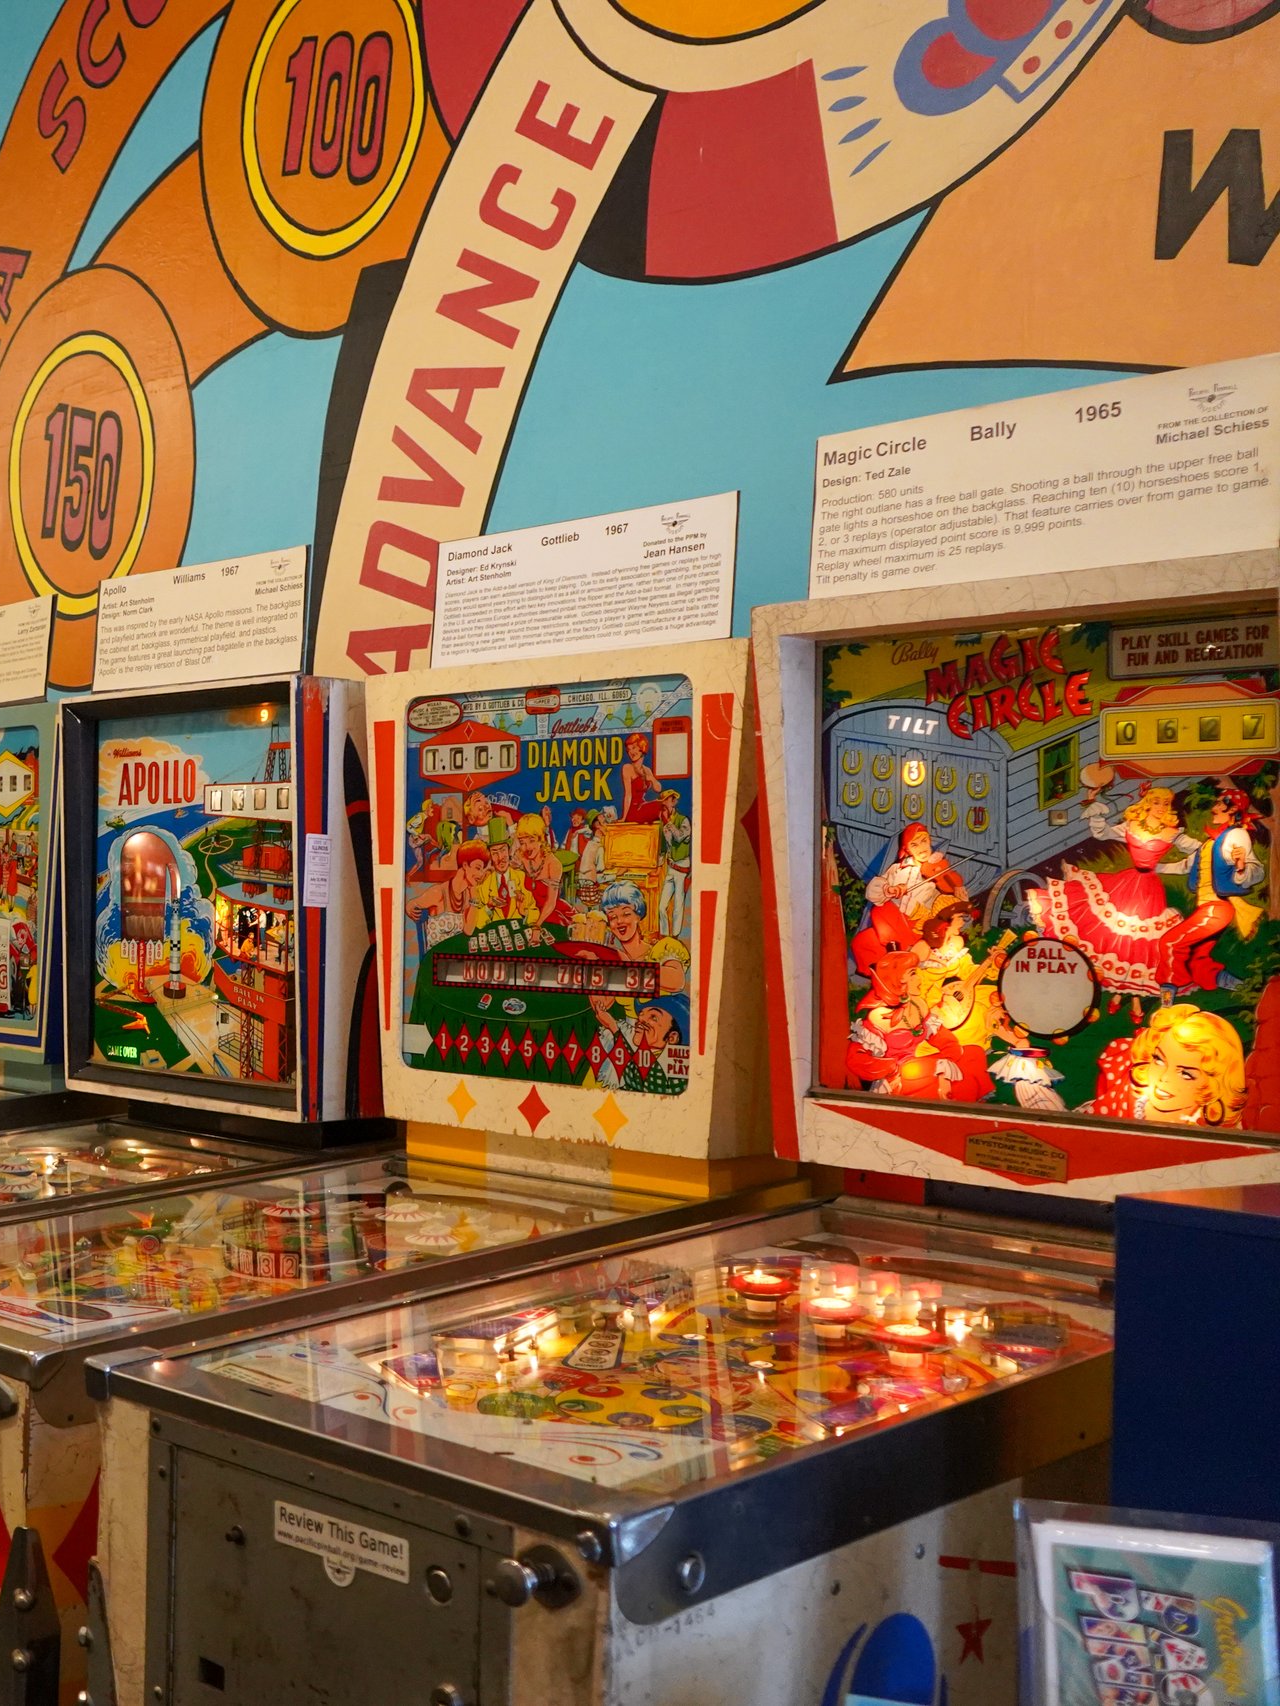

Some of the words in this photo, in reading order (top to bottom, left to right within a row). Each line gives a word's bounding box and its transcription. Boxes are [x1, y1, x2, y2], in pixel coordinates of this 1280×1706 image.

[282, 31, 394, 186] 100
[345, 80, 615, 676] ADVANCE
[1157, 420, 1181, 430] FROM
[1183, 417, 1200, 426] THE
[1201, 408, 1255, 423] COLLECTION
[1257, 405, 1268, 414] OF
[823, 445, 872, 466] Magic
[875, 436, 927, 456] Circle
[970, 420, 1016, 441] Bally
[1075, 400, 1121, 423] 1965
[1155, 426, 1209, 444] Michael
[1213, 418, 1269, 436] Schiess
[41, 402, 121, 561] 150
[820, 510, 839, 520] The
[841, 506, 863, 519] right
[865, 502, 902, 514] outlane
[904, 499, 924, 508] has
[925, 497, 933, 506] a
[935, 494, 956, 504] free
[958, 489, 977, 501] ball
[1010, 478, 1059, 493] Shooting
[1062, 477, 1070, 486] a
[1072, 471, 1094, 484] ball
[1097, 464, 1142, 481] through
[1146, 463, 1165, 474] the
[1168, 457, 1205, 471] upper
[1208, 453, 1232, 464] free
[1236, 447, 1258, 460] ball
[822, 475, 861, 488] Design:
[864, 468, 885, 480] Ted
[887, 466, 911, 478] Zale
[821, 493, 874, 508] Production:
[877, 487, 897, 500] 580
[899, 485, 924, 496] units
[447, 546, 488, 562] Diamond
[490, 542, 512, 555] Jack
[540, 531, 580, 546] Gottlieb
[605, 522, 628, 536] 1967
[643, 548, 666, 559] Jean
[668, 542, 705, 555] Hansen
[446, 566, 477, 576] Designer:
[479, 563, 489, 571] Ed
[490, 560, 516, 570] Krynski
[102, 584, 126, 597] Apollo
[172, 572, 206, 585] Williams
[220, 564, 239, 576] 1967
[445, 577, 466, 586] Artist:
[479, 570, 511, 581] Stenholm
[254, 585, 278, 595] Michael
[279, 582, 303, 592] Schiess
[100, 611, 121, 620] Design:
[122, 608, 138, 616] Norm
[138, 605, 153, 614] Clark
[1121, 635, 1151, 650] PLAY
[1157, 632, 1190, 648] SKILL
[1196, 627, 1239, 644] GAMES
[1246, 624, 1269, 640] FOR
[891, 641, 940, 666] Bally
[1127, 651, 1149, 667] FUN
[1155, 650, 1179, 665] AND
[1185, 643, 1264, 663] RECREATION
[925, 628, 1068, 706] MAGIC
[946, 669, 1094, 741] CIRCLE
[260, 708, 268, 722] 9
[551, 717, 598, 739] Gottlieb's
[887, 714, 939, 736] TILT
[528, 736, 624, 769] DIAMOND
[118, 759, 196, 806] APOLLO
[536, 767, 613, 803] JACK
[1027, 946, 1067, 961] BALL
[1015, 961, 1033, 974] IN
[1036, 961, 1078, 976] PLAY
[233, 986, 251, 998] BALL
[256, 995, 264, 1003] IN
[237, 996, 257, 1009] PLAY
[440, 1033, 447, 1047] 1
[460, 1035, 468, 1052] 2
[481, 1036, 489, 1053] 3
[501, 1038, 510, 1055] 4
[524, 1040, 532, 1057] 5
[107, 1045, 122, 1056] GAME
[122, 1046, 138, 1059] OVER
[546, 1042, 555, 1059] 6
[569, 1044, 577, 1061] 7
[591, 1045, 600, 1063] 8
[615, 1047, 624, 1065] 9
[638, 1050, 650, 1068] 10
[667, 1047, 689, 1059] BALLS
[667, 1065, 689, 1076] PLAY
[279, 1506, 324, 1534] Review
[328, 1521, 355, 1544] This
[359, 1531, 404, 1561] Game!
